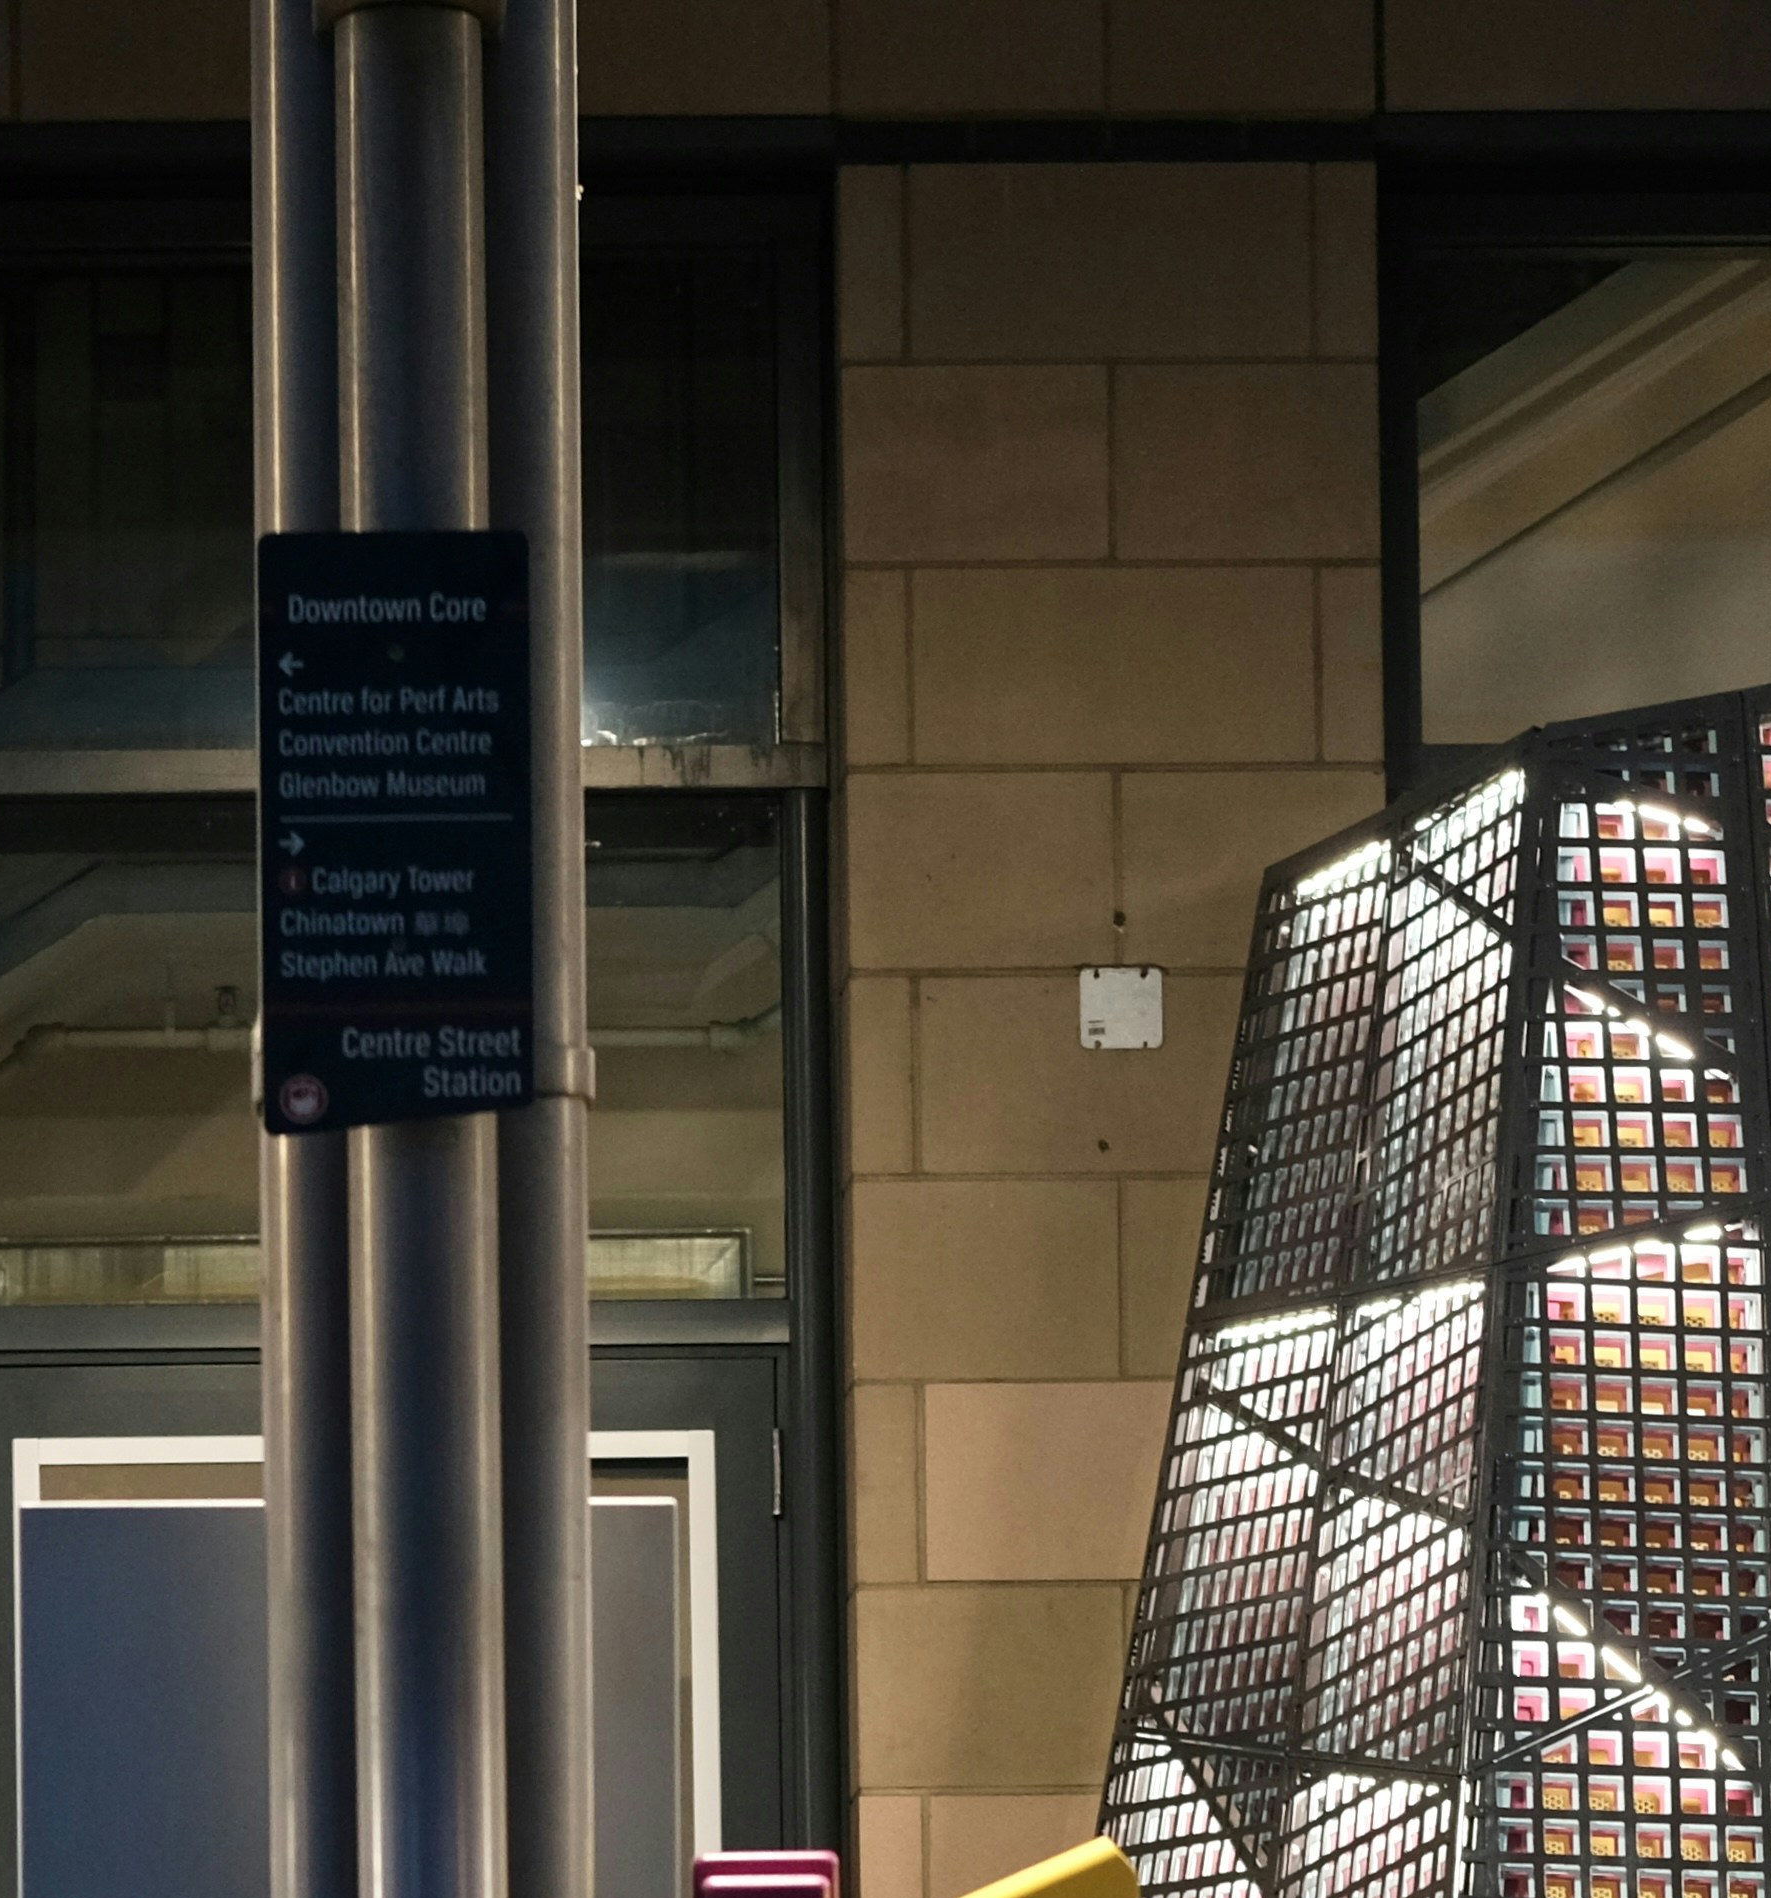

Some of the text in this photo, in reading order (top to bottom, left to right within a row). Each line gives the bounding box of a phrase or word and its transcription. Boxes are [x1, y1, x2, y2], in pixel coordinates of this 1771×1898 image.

[288, 591, 487, 625] Downtown Core
[278, 685, 500, 716] Centre for Perf Arts
[278, 727, 492, 757] Convention Centre
[279, 768, 486, 799] Glenbow Museum
[311, 865, 474, 900] Calgary Tower
[280, 907, 405, 937] Chinatown
[280, 947, 487, 983] Stephen Ave Walk
[341, 1024, 522, 1059] Centre Street
[423, 1065, 522, 1098] Station
